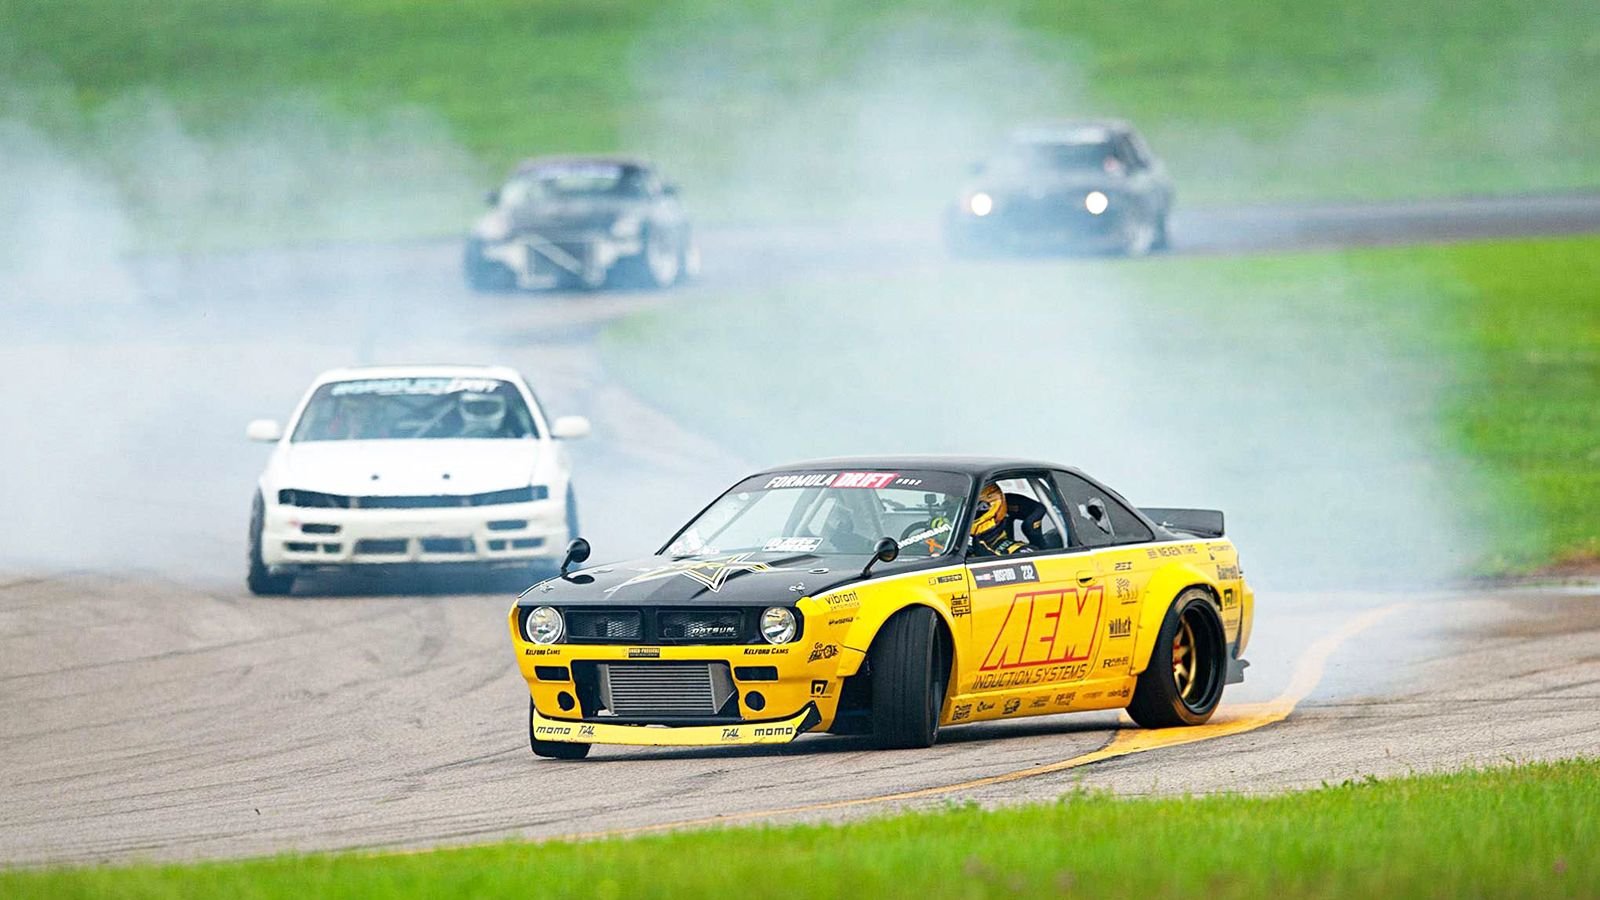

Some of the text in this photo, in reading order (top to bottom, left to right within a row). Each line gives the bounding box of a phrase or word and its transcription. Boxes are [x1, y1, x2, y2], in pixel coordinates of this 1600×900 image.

[764, 474, 838, 489] FORMULA
[833, 472, 895, 488] DRIFT
[1020, 565, 1035, 581] 232
[824, 591, 859, 606] vibrant
[690, 626, 737, 636] DATSUN
[979, 585, 1104, 671] AEM
[525, 648, 561, 656] KELFORD CAMS
[771, 647, 789, 655] CAMS
[971, 663, 1088, 689] INDUCTION SYSTEMS
